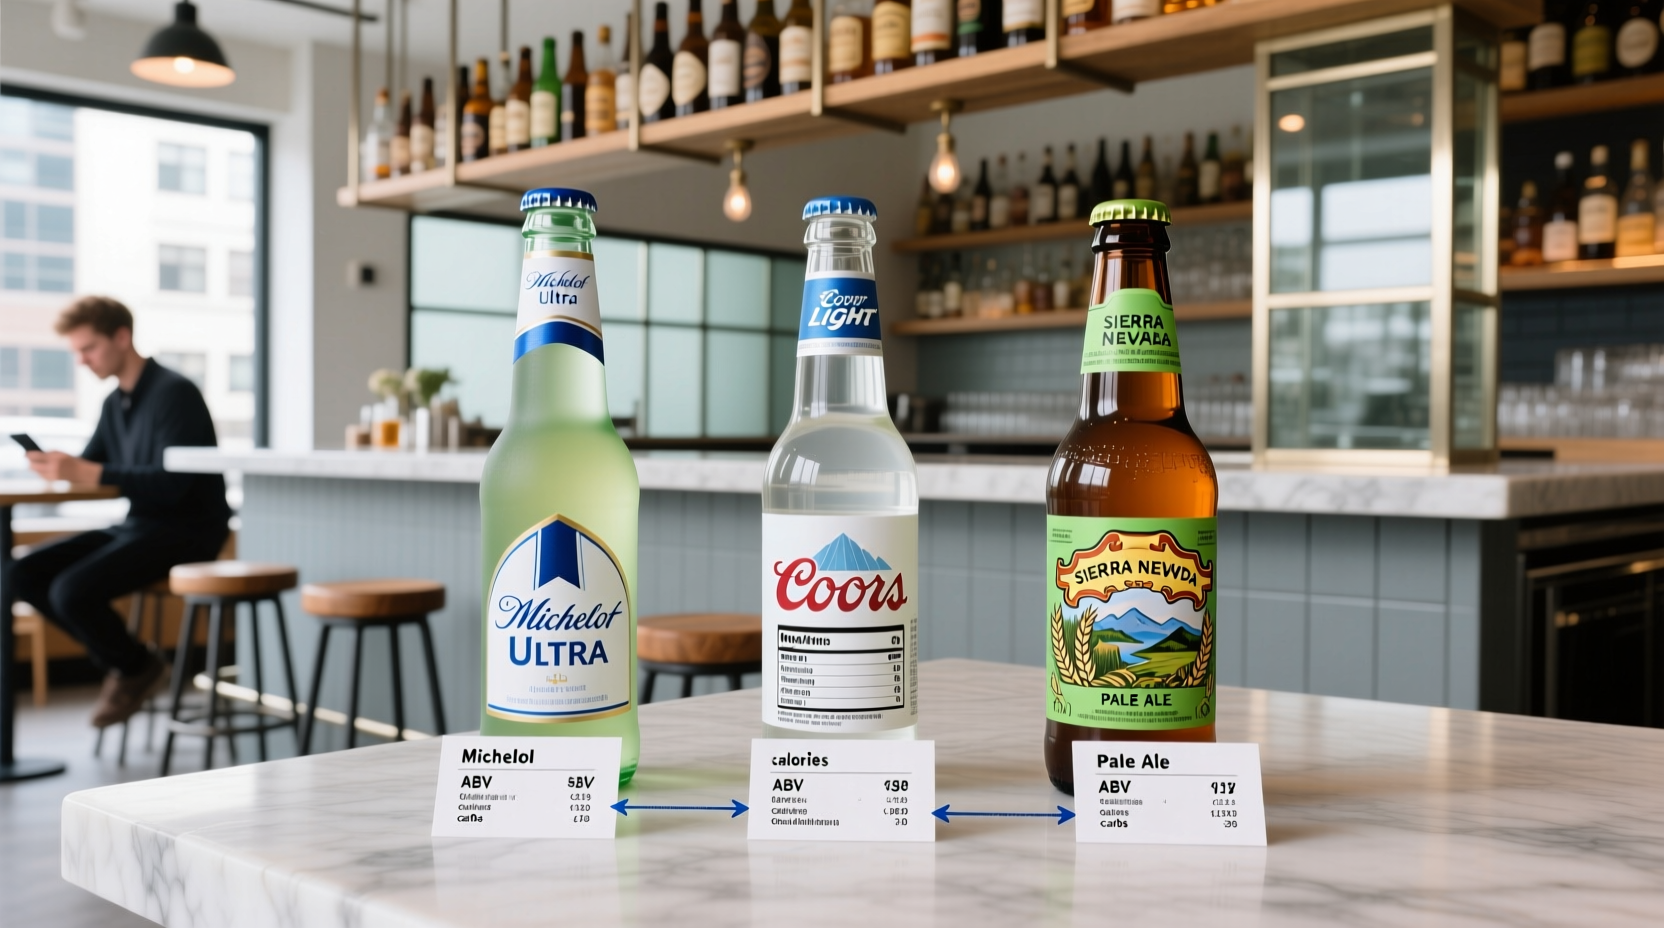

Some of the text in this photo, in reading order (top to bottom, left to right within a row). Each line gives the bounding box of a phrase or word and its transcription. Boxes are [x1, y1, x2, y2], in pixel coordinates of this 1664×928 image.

[539, 290, 578, 305] Ultra
[1103, 314, 1165, 329] SIERRA
[1074, 560, 1133, 585] SIERRA
[773, 557, 908, 613] Coors
[509, 636, 609, 667] ULTRA
[1101, 693, 1172, 706] PALE ALE
[1097, 753, 1170, 769] Pale Ale
[460, 775, 492, 789] ABV
[772, 778, 804, 792] ABV
[1098, 780, 1131, 794] ABV
